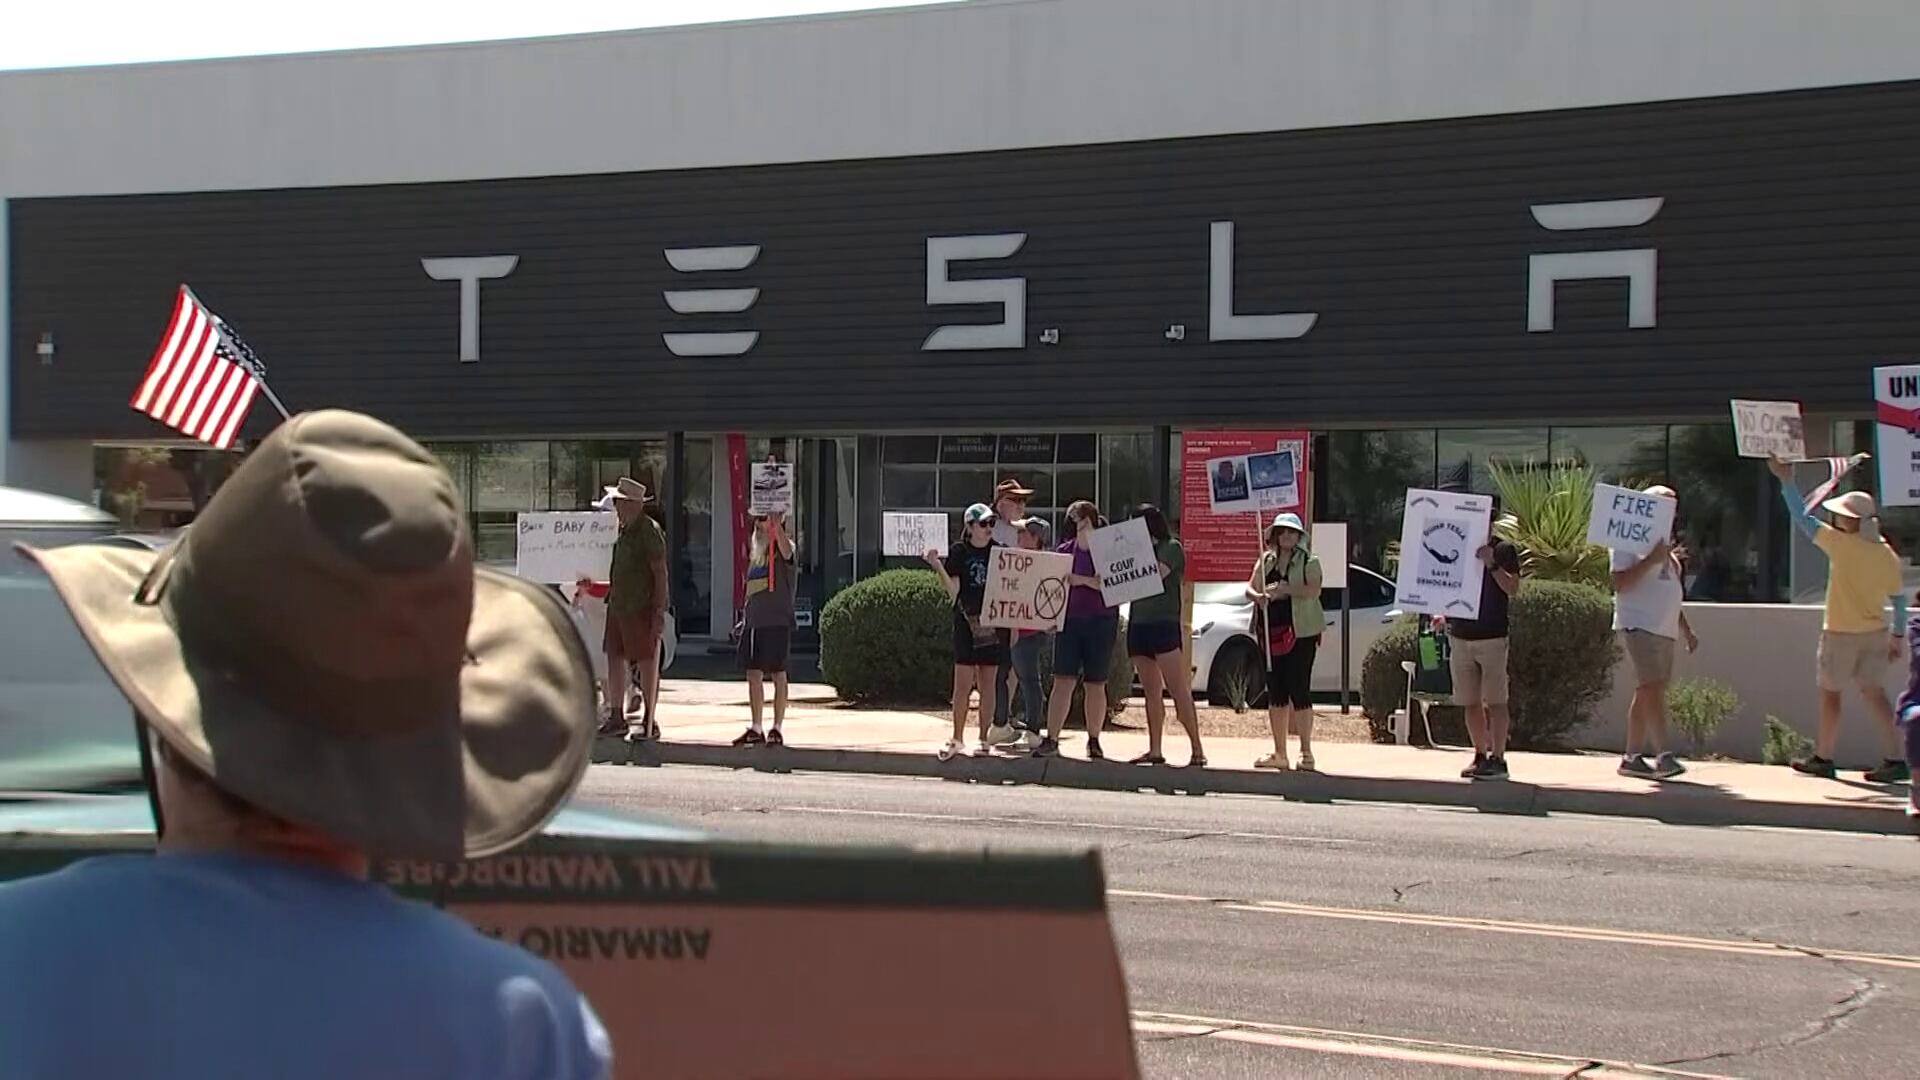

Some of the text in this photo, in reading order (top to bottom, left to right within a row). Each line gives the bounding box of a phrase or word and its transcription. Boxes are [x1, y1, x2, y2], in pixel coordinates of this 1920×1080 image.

[421, 196, 1664, 363] TESLA
[1612, 495, 1657, 518] FIRE
[554, 521, 585, 534] BABY
[1607, 518, 1652, 543] MUSK
[1110, 557, 1136, 574] COUP
[1001, 577, 1020, 591] THE
[634, 855, 717, 890] TALL
[519, 925, 712, 961] ARMARIO
